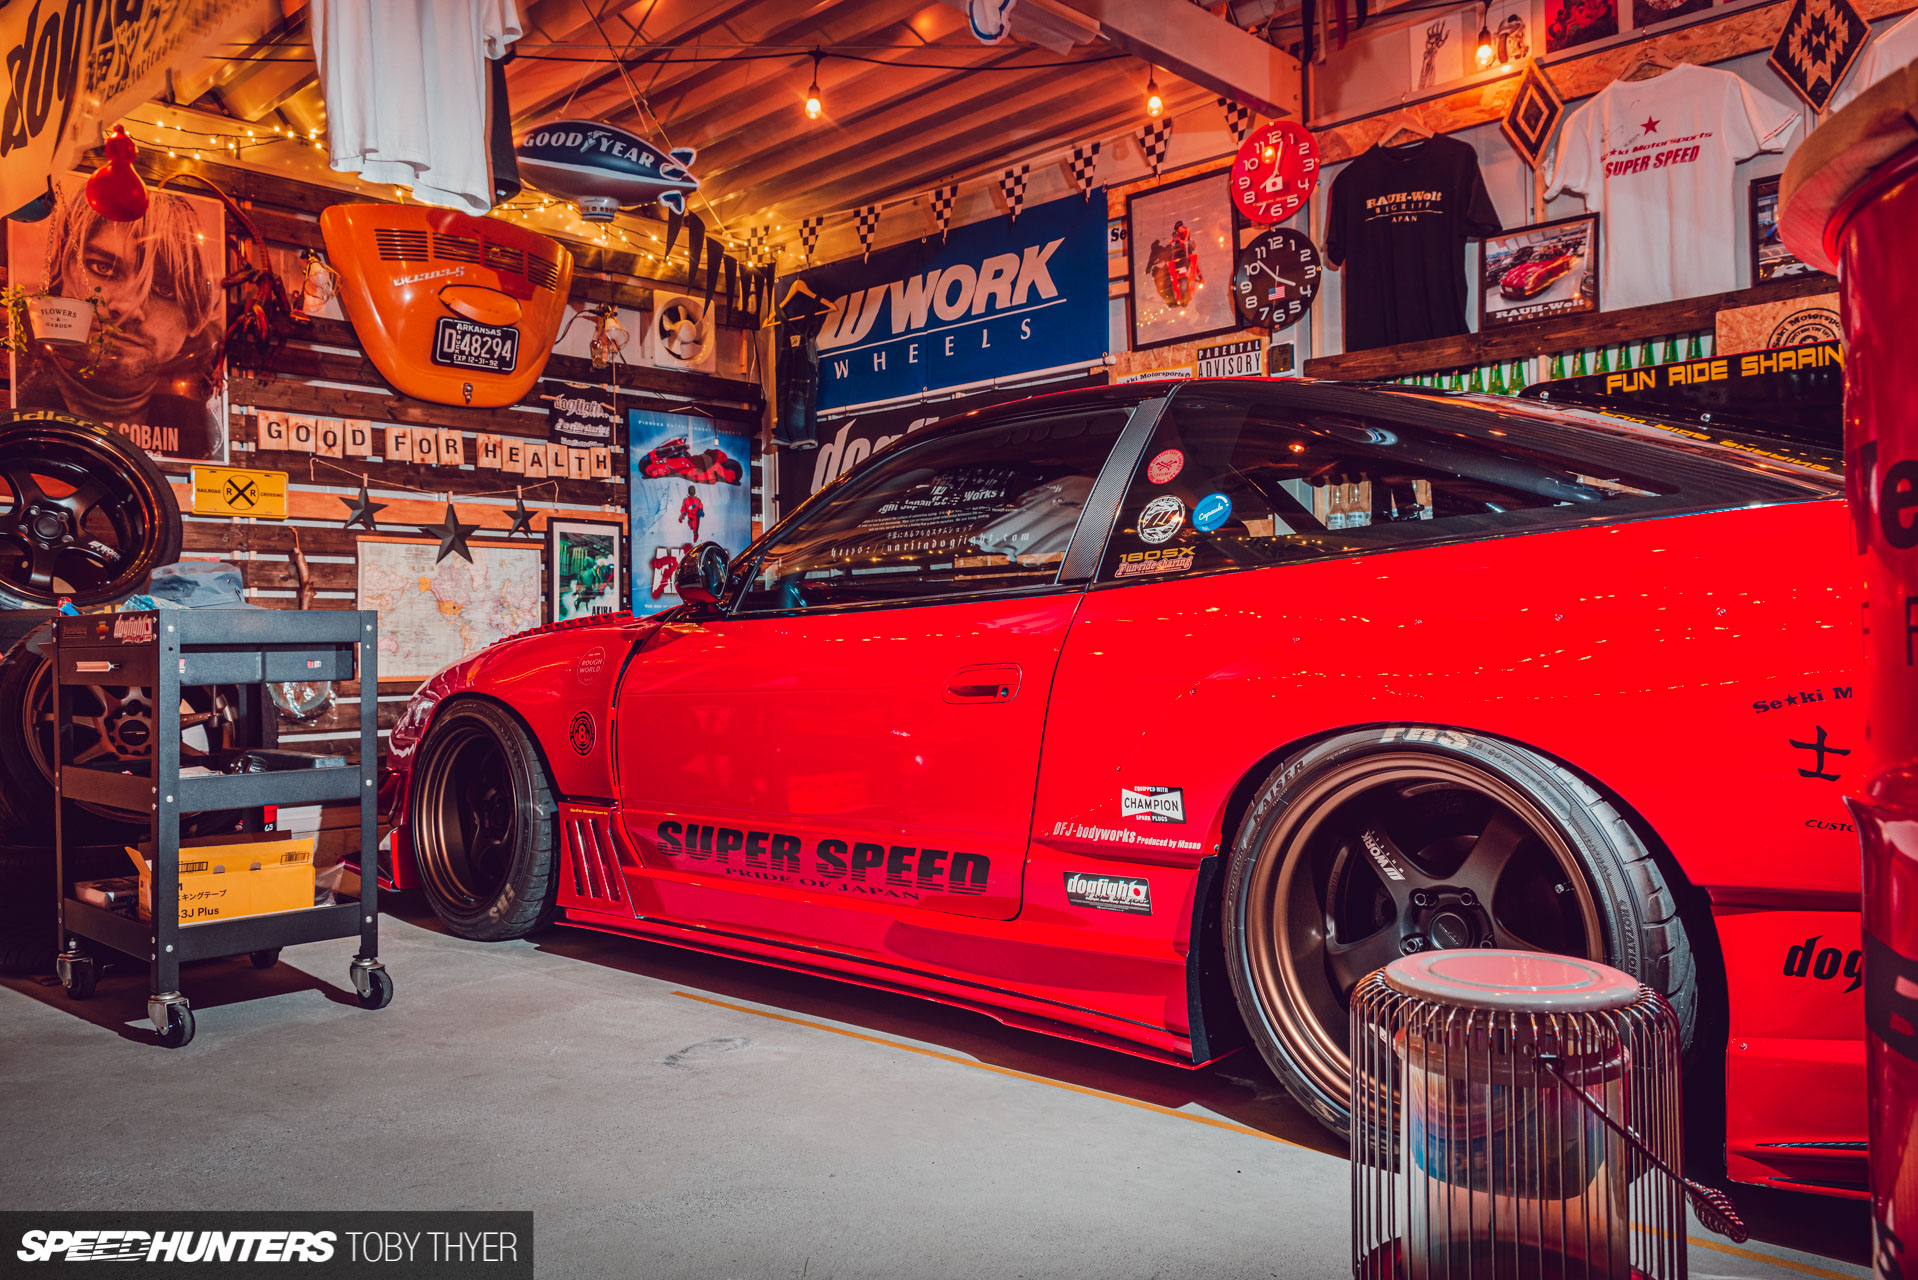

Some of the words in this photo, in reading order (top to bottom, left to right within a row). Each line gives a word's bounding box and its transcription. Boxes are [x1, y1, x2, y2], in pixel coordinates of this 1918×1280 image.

[1267, 130, 1282, 144] 12
[1289, 133, 1294, 144] 1
[1632, 132, 1713, 152] Motorsports
[523, 132, 583, 147] GOOD
[599, 137, 655, 168] YEAR
[1254, 141, 1265, 154] 11
[1299, 142, 1309, 155] 2
[1243, 158, 1258, 171] 10
[1303, 158, 1314, 172] 3
[1605, 155, 1651, 178] SUPER
[1653, 145, 1700, 168] SPEED
[1239, 176, 1250, 189] 9
[1298, 178, 1309, 190] 4
[1243, 191, 1255, 204] 8
[1287, 194, 1299, 207] 5
[1270, 204, 1283, 216] 6
[1268, 236, 1283, 250] 12
[1290, 239, 1295, 251] 1
[1255, 246, 1266, 259] 11
[1300, 249, 1311, 262] 2
[1244, 262, 1260, 276] 10
[1304, 265, 1316, 279] 3
[890, 237, 1065, 334] WORK
[1240, 281, 1252, 294] 9
[1300, 284, 1312, 297] 4
[1245, 296, 1257, 308] 8
[1289, 300, 1301, 314] 5
[40, 308, 77, 319] FLOWERS
[1259, 307, 1269, 320] 7
[1273, 309, 1285, 322] 6
[1788, 313, 1841, 331] Motorspo
[457, 323, 501, 336] ARKANSAS
[460, 333, 512, 361] 48294
[834, 319, 1031, 379] WHEELS
[1199, 340, 1261, 360] PARENTAL
[1198, 352, 1261, 378] ADVISORY
[1606, 370, 1655, 395] FUN
[1668, 359, 1729, 386] RIDE
[1741, 343, 1844, 376] SHARIN
[13, 410, 109, 436] idlers
[267, 421, 366, 448] GOOD
[394, 434, 458, 456] FOR
[484, 442, 607, 472] HEALTH
[250, 489, 256, 497] R
[1119, 546, 1196, 562] 180SX
[1253, 760, 1305, 824] KAISER
[1124, 797, 1179, 812] CHAMPION
[1053, 821, 1136, 843] DFJ-bodyworks
[1136, 836, 1168, 847] Produced
[1169, 839, 1177, 849] by
[1361, 832, 1389, 868] WORK
[657, 820, 801, 873] SUPER
[815, 839, 991, 896] SPEED
[726, 867, 794, 886] PRIDE
[799, 878, 834, 890] OF
[837, 882, 920, 901] JAPAN
[179, 909, 194, 919] 3J
[198, 906, 219, 917] Plus
